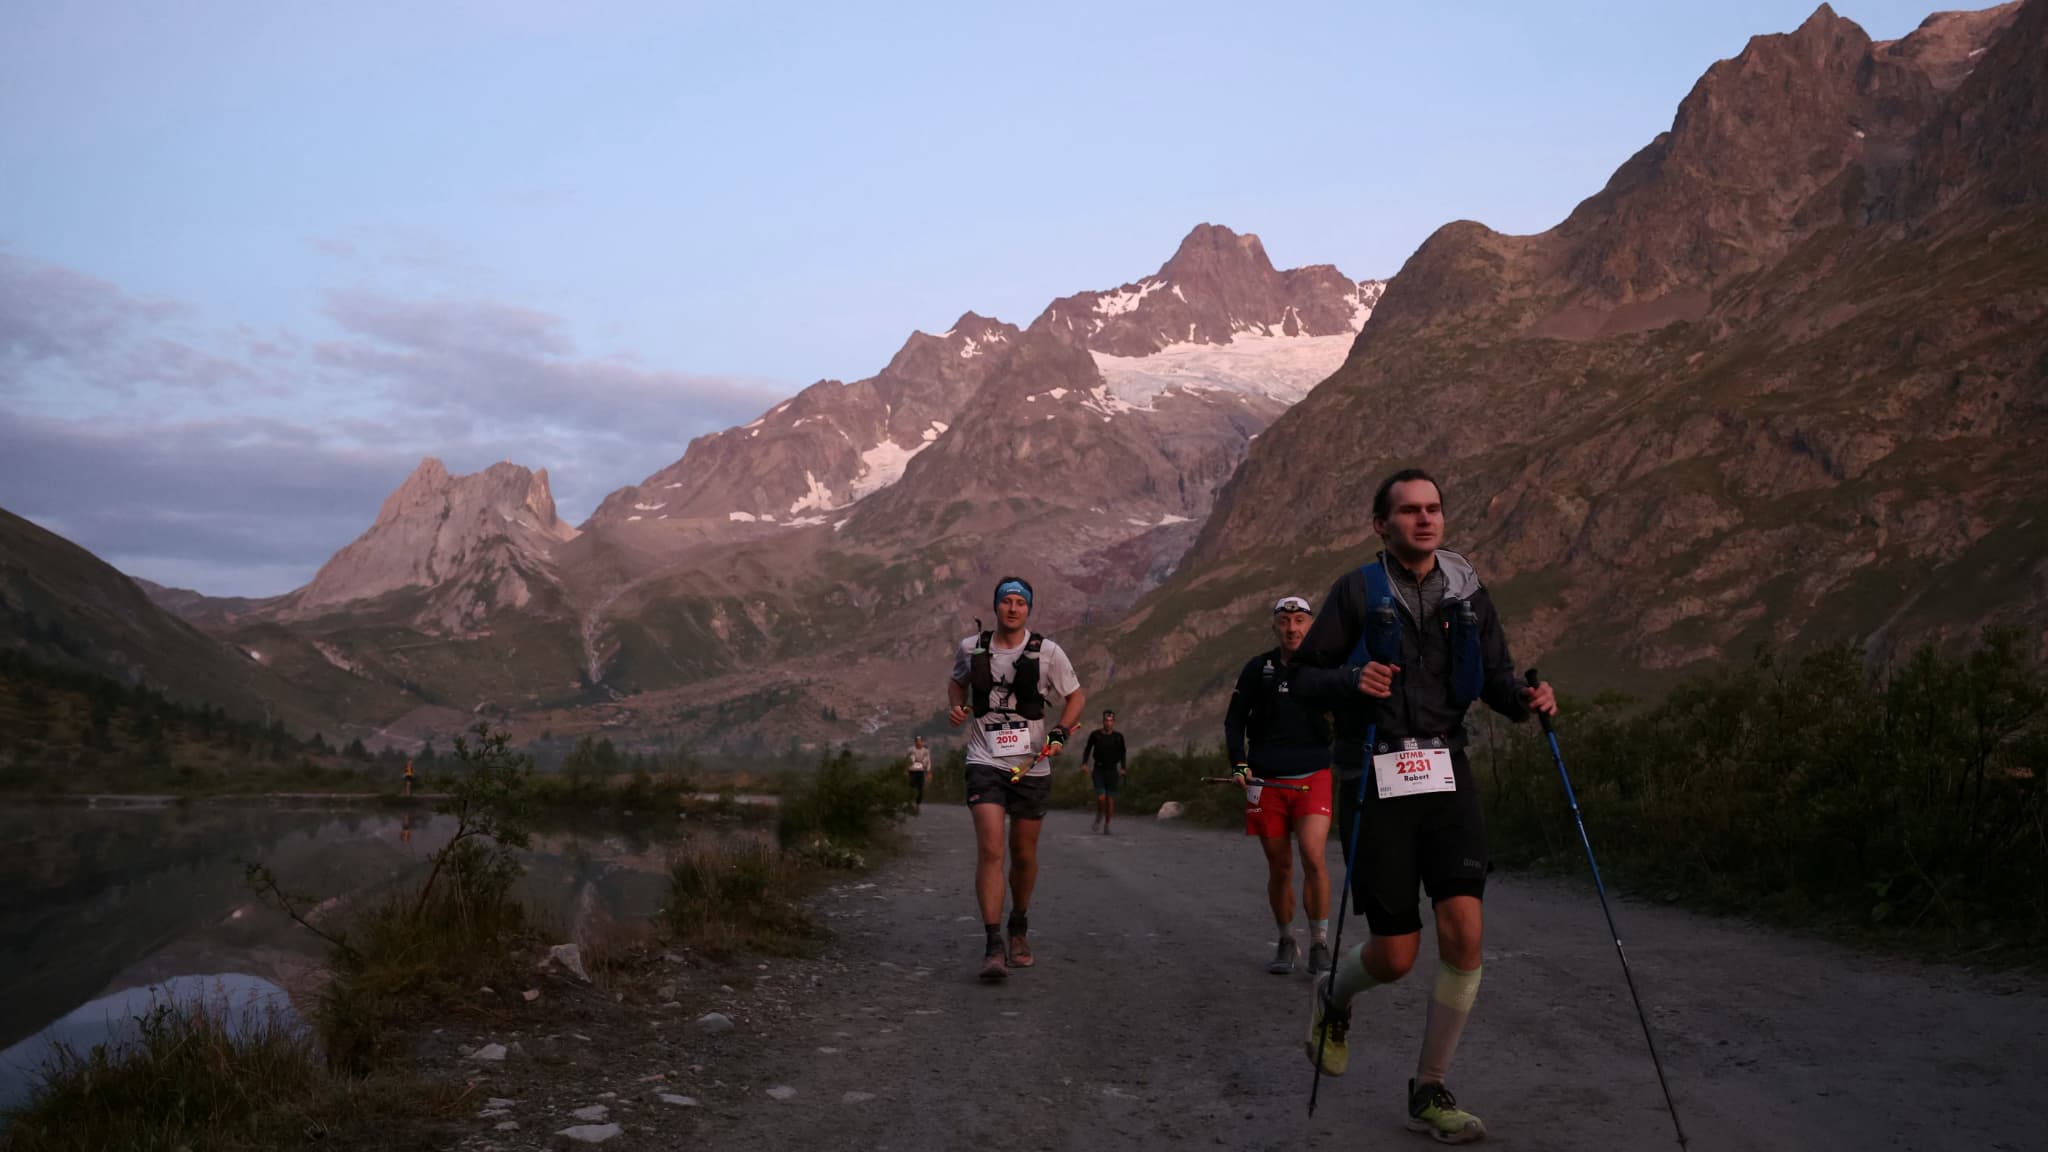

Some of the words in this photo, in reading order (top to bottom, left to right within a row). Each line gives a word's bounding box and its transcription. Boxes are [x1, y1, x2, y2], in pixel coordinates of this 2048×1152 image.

[996, 735, 1018, 744] 2010
[1399, 751, 1424, 760] UTMB
[1396, 759, 1432, 774] 2231
[1404, 774, 1429, 782] Robert
